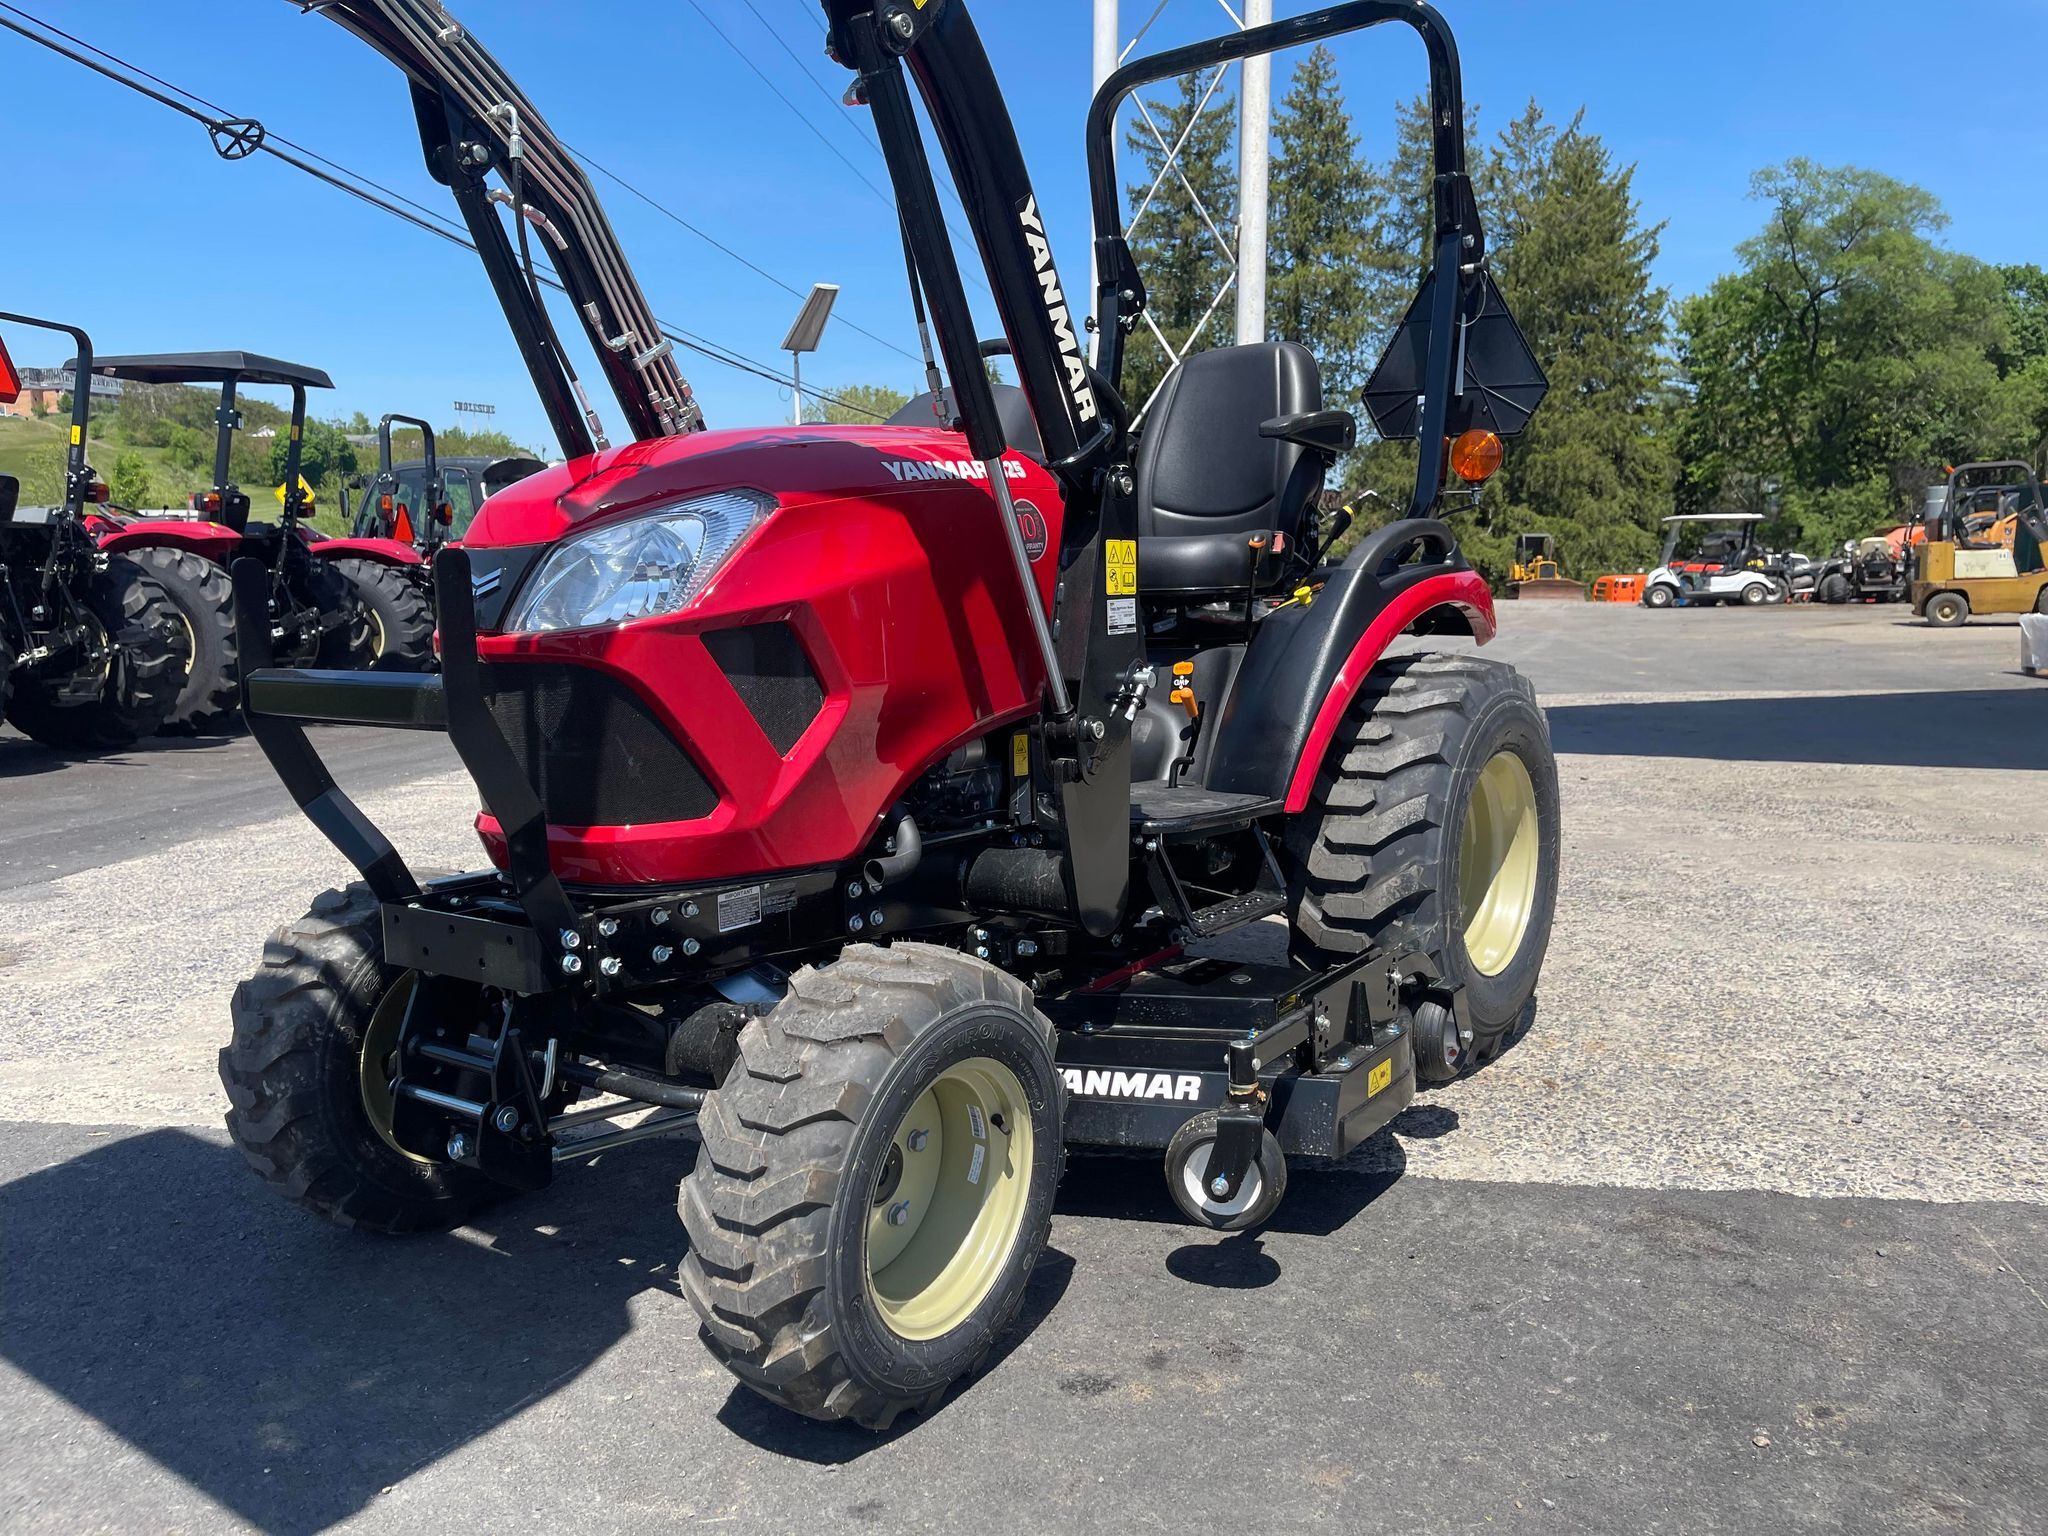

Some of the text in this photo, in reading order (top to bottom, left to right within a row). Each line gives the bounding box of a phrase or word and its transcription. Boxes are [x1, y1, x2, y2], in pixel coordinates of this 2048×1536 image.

[1019, 194, 1096, 422] YANMAR
[881, 460, 1027, 481] YANMAR 25
[724, 888, 753, 900] IMPORTANT
[1056, 1068, 1202, 1101] ANMAR
